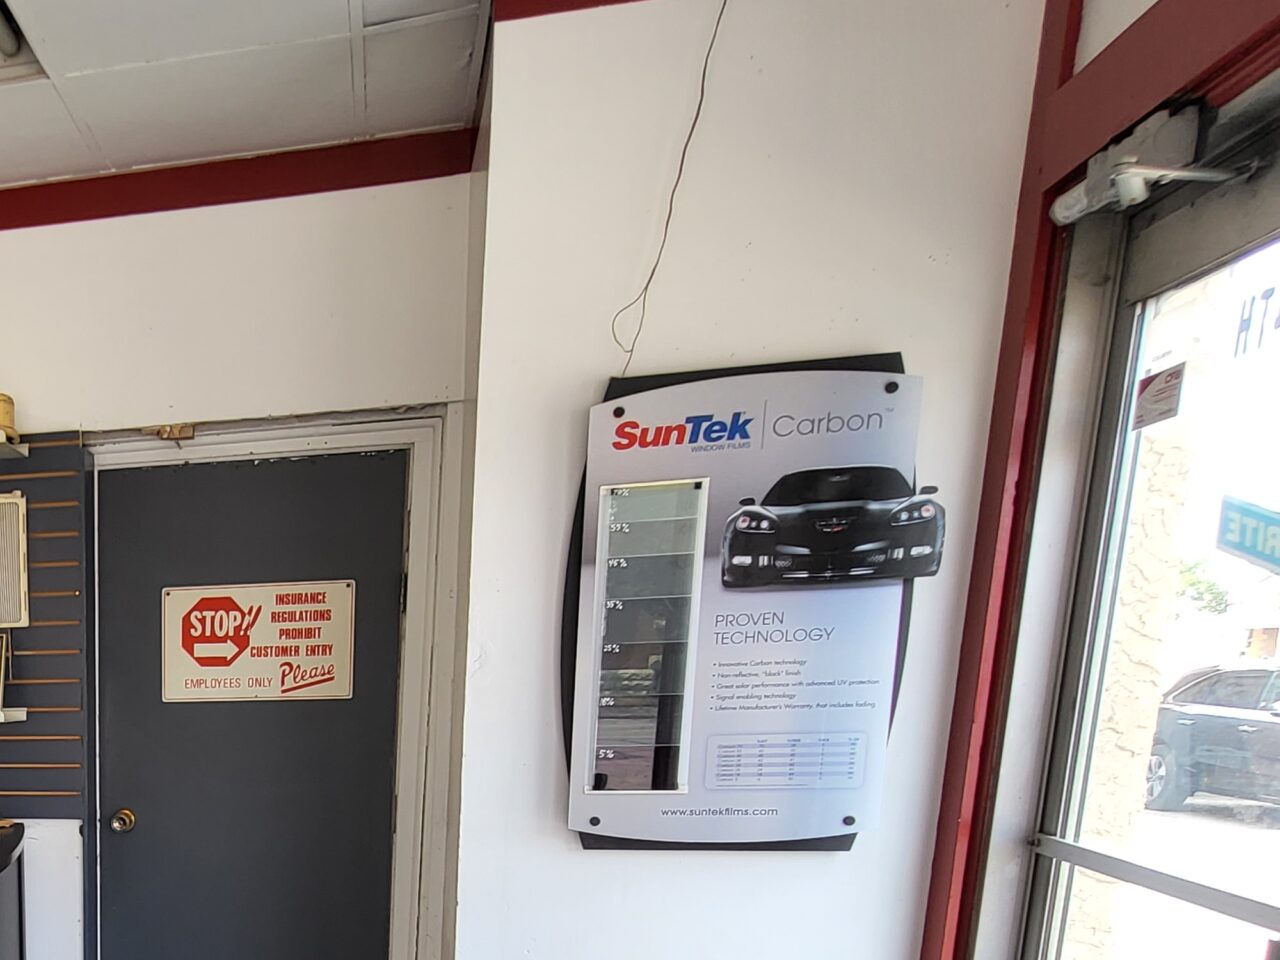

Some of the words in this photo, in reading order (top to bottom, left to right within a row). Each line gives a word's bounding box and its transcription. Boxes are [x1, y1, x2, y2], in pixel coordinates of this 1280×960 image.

[612, 411, 754, 451] SunTek
[773, 411, 883, 437] Carbon
[691, 444, 725, 453] WINDOW
[727, 442, 751, 450] FILMS
[275, 592, 327, 606] INSURANCE
[271, 609, 332, 623] REGULATIONS
[715, 611, 784, 627] PROVEN
[278, 626, 322, 640] PROHIBIT
[713, 627, 835, 645] TECHNOLOGY
[250, 645, 300, 658] CUSTOMER
[305, 644, 333, 657] ENTRY
[279, 661, 335, 688] Please
[184, 678, 241, 689] EMPLOYEES
[247, 677, 273, 688] ONLY
[598, 749, 615, 759] 5%
[661, 807, 778, 817] www.suntekfilms.com
